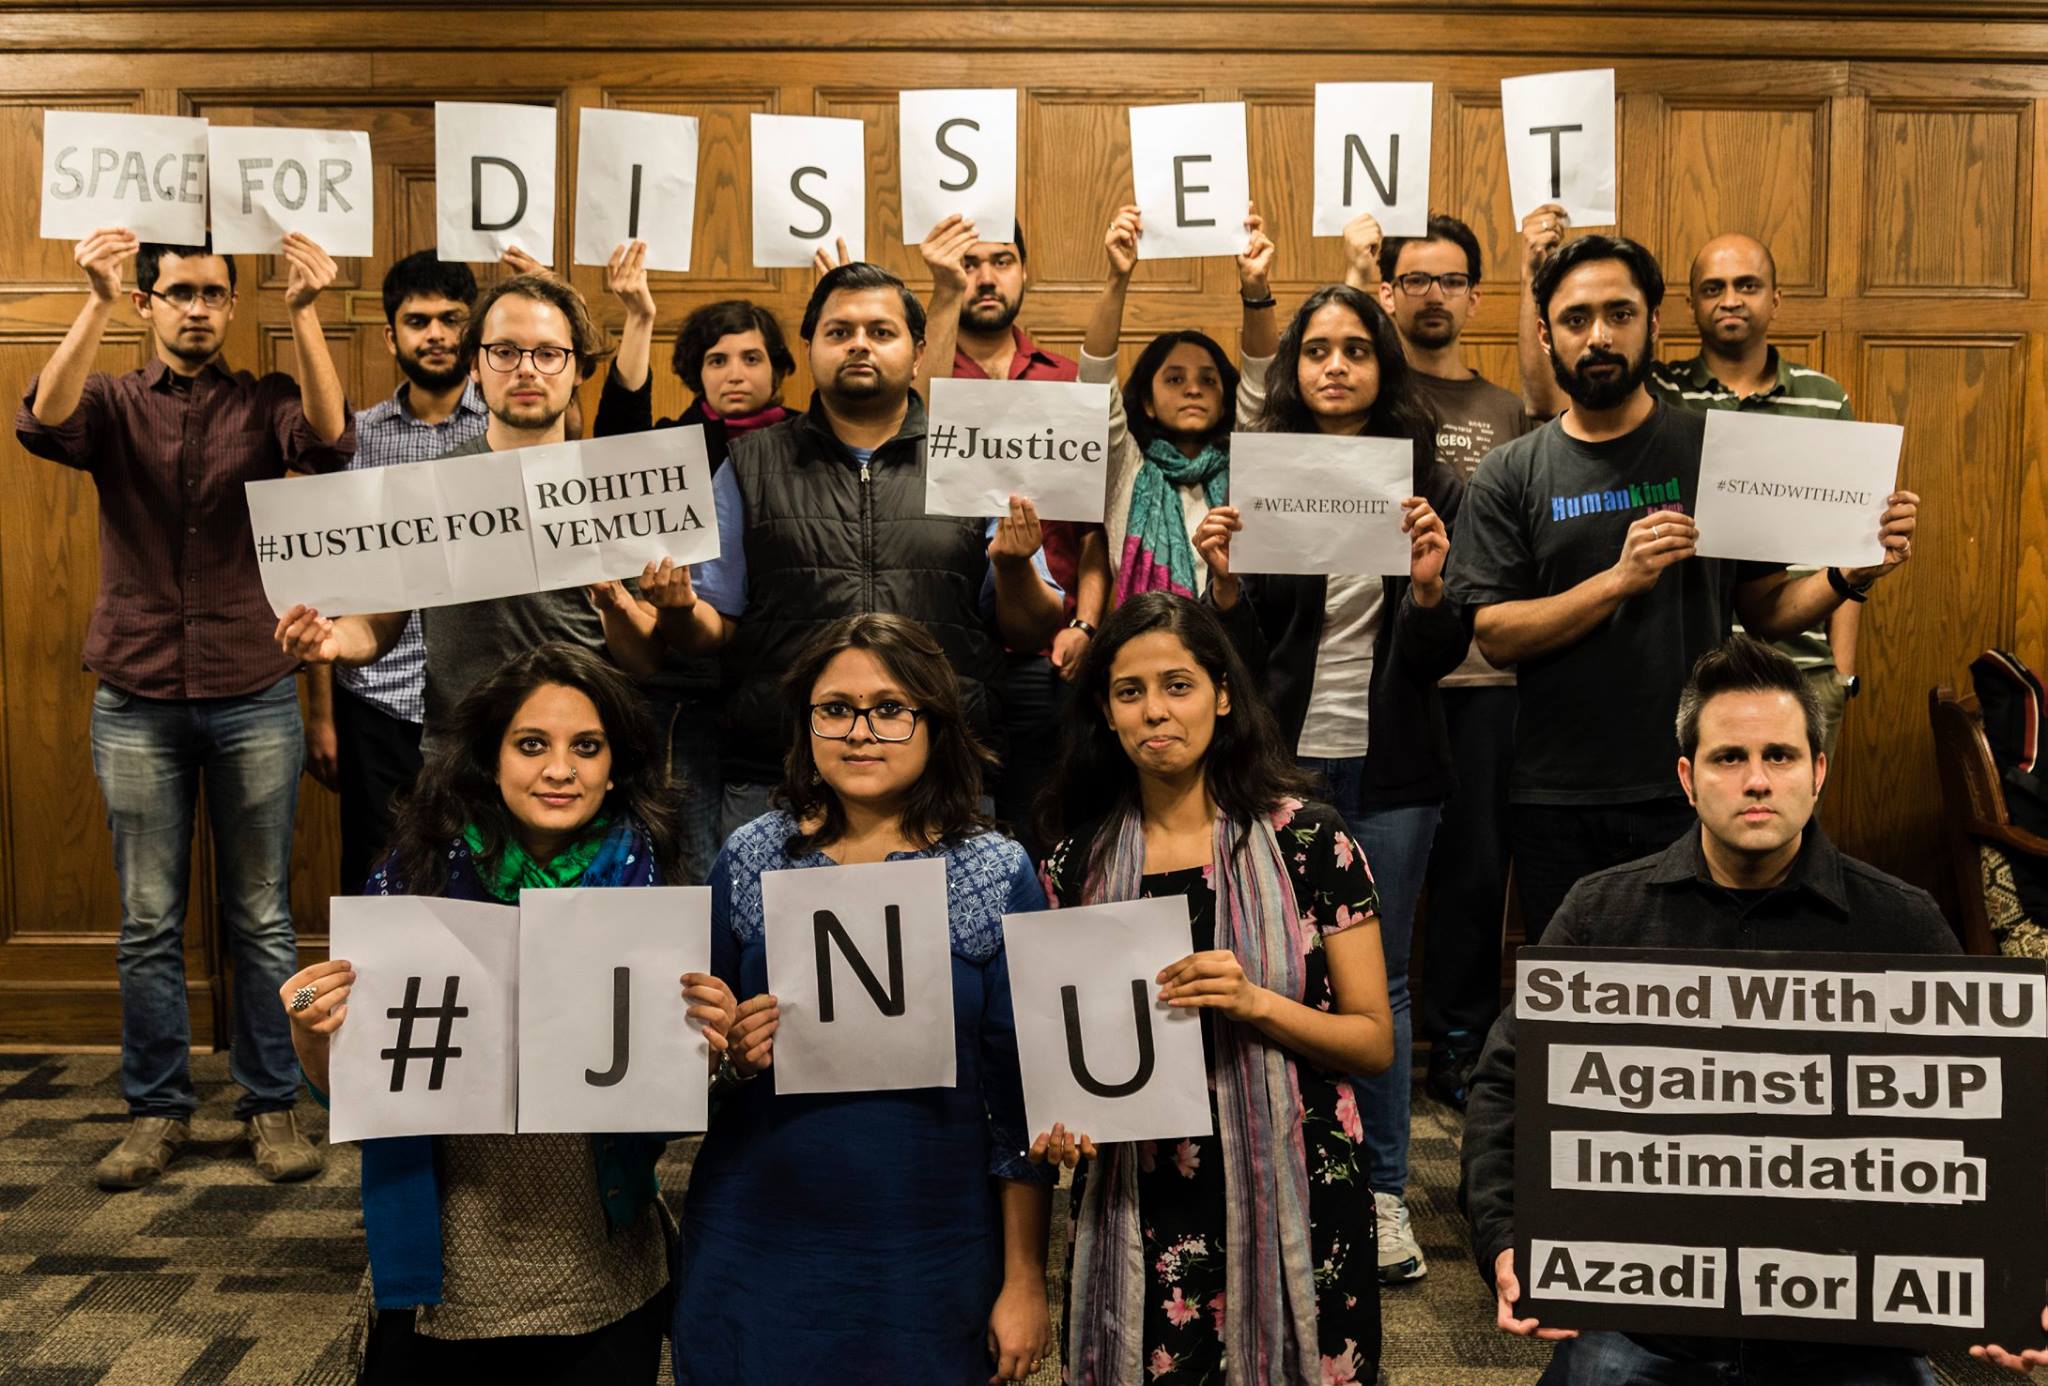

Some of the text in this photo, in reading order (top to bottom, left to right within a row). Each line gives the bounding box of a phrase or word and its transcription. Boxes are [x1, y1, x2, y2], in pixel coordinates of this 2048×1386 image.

[50, 146, 353, 214] SPACE FOR
[930, 425, 1101, 462] #Justice
[536, 465, 689, 509] ROHITH
[1253, 497, 1390, 515] #WEAREROHIT
[1716, 479, 1873, 506] #STANDWITHJNU
[258, 507, 523, 562] #JUSTICE FOR
[541, 504, 705, 549] VEMULA
[1525, 967, 2033, 1027] Stand With JNU
[1570, 1051, 1986, 1108] Against BJP
[1577, 1138, 1981, 1195] Intimidation
[1536, 1246, 1971, 1316] Azadi for All
